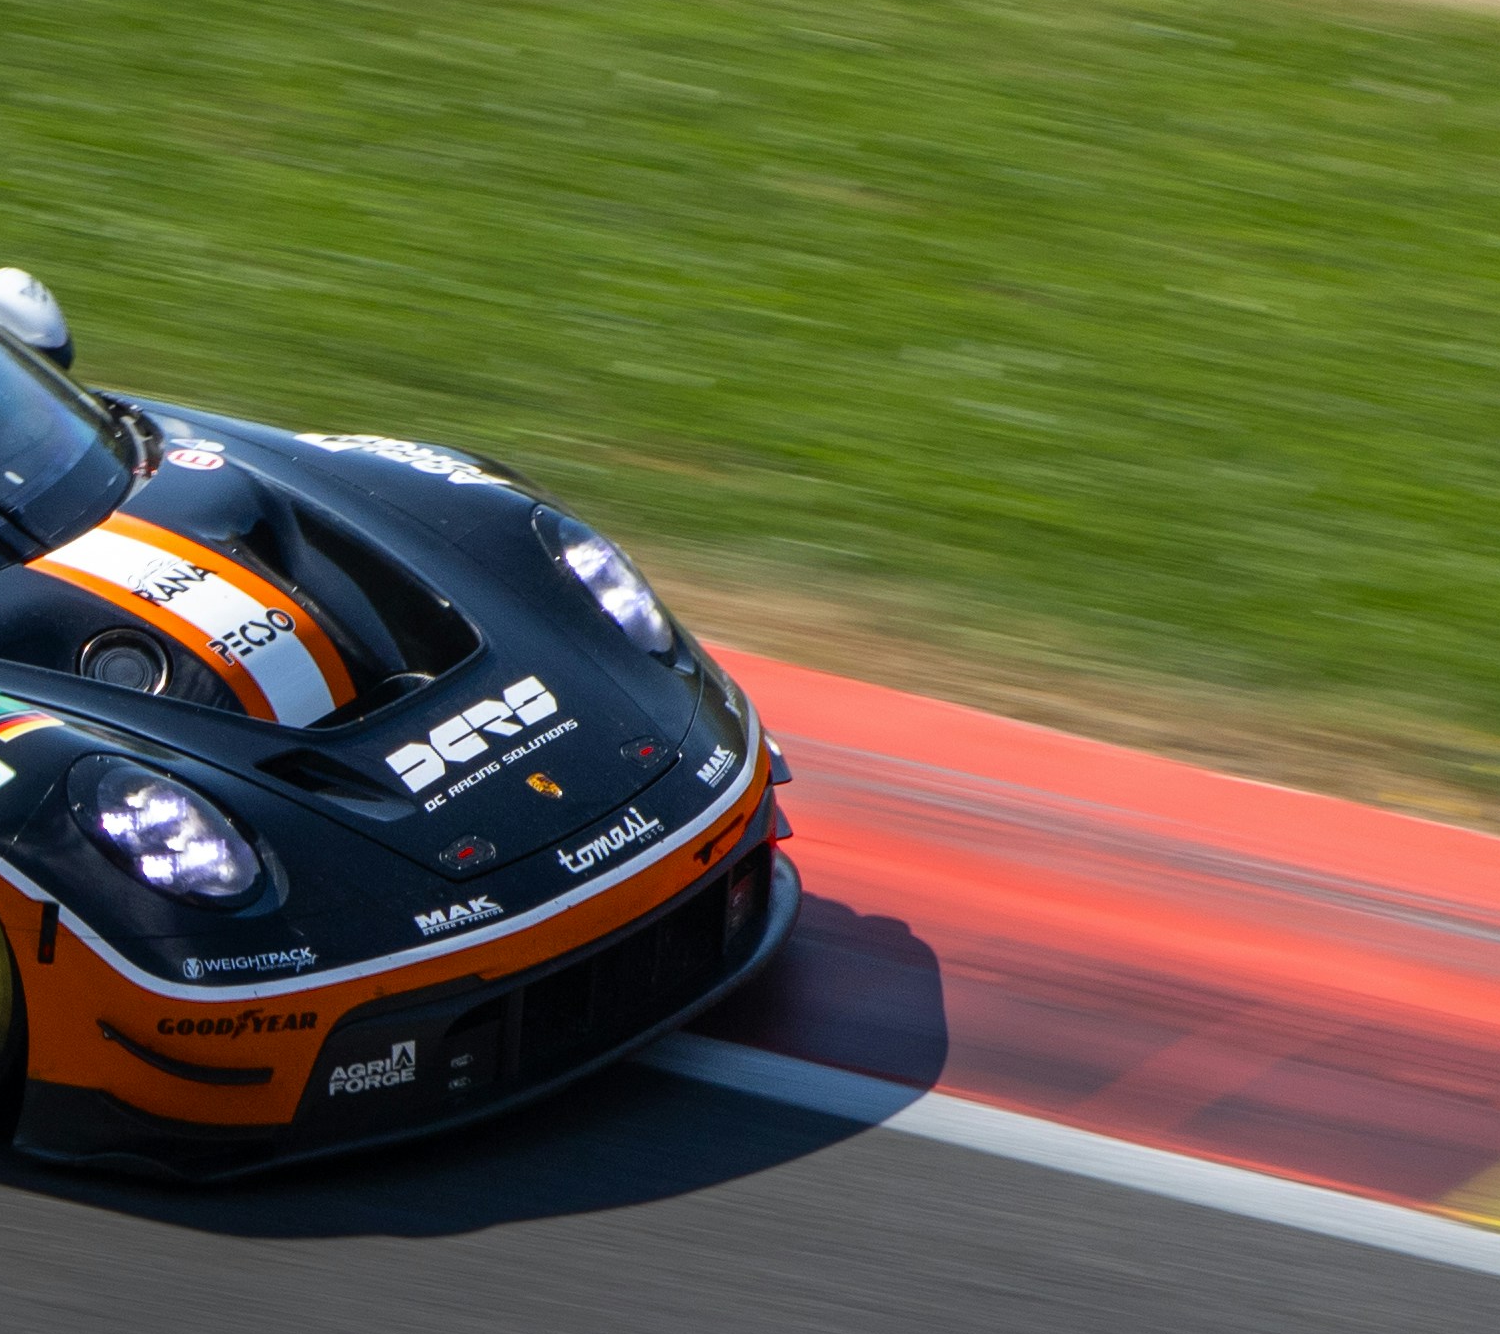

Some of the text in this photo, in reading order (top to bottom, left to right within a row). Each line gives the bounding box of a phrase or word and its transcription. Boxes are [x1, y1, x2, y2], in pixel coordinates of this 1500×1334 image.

[425, 719, 579, 813] DC RACING SOLUTIONS
[697, 744, 731, 784] MAK
[557, 806, 660, 874] tomasi
[638, 824, 665, 844] AUTO
[414, 895, 499, 929] MAK
[204, 946, 314, 972] WEIGHTPACK
[157, 1007, 318, 1040] GOODYEAR
[328, 1067, 416, 1097] FORGE
[330, 1058, 391, 1081] AGRI
